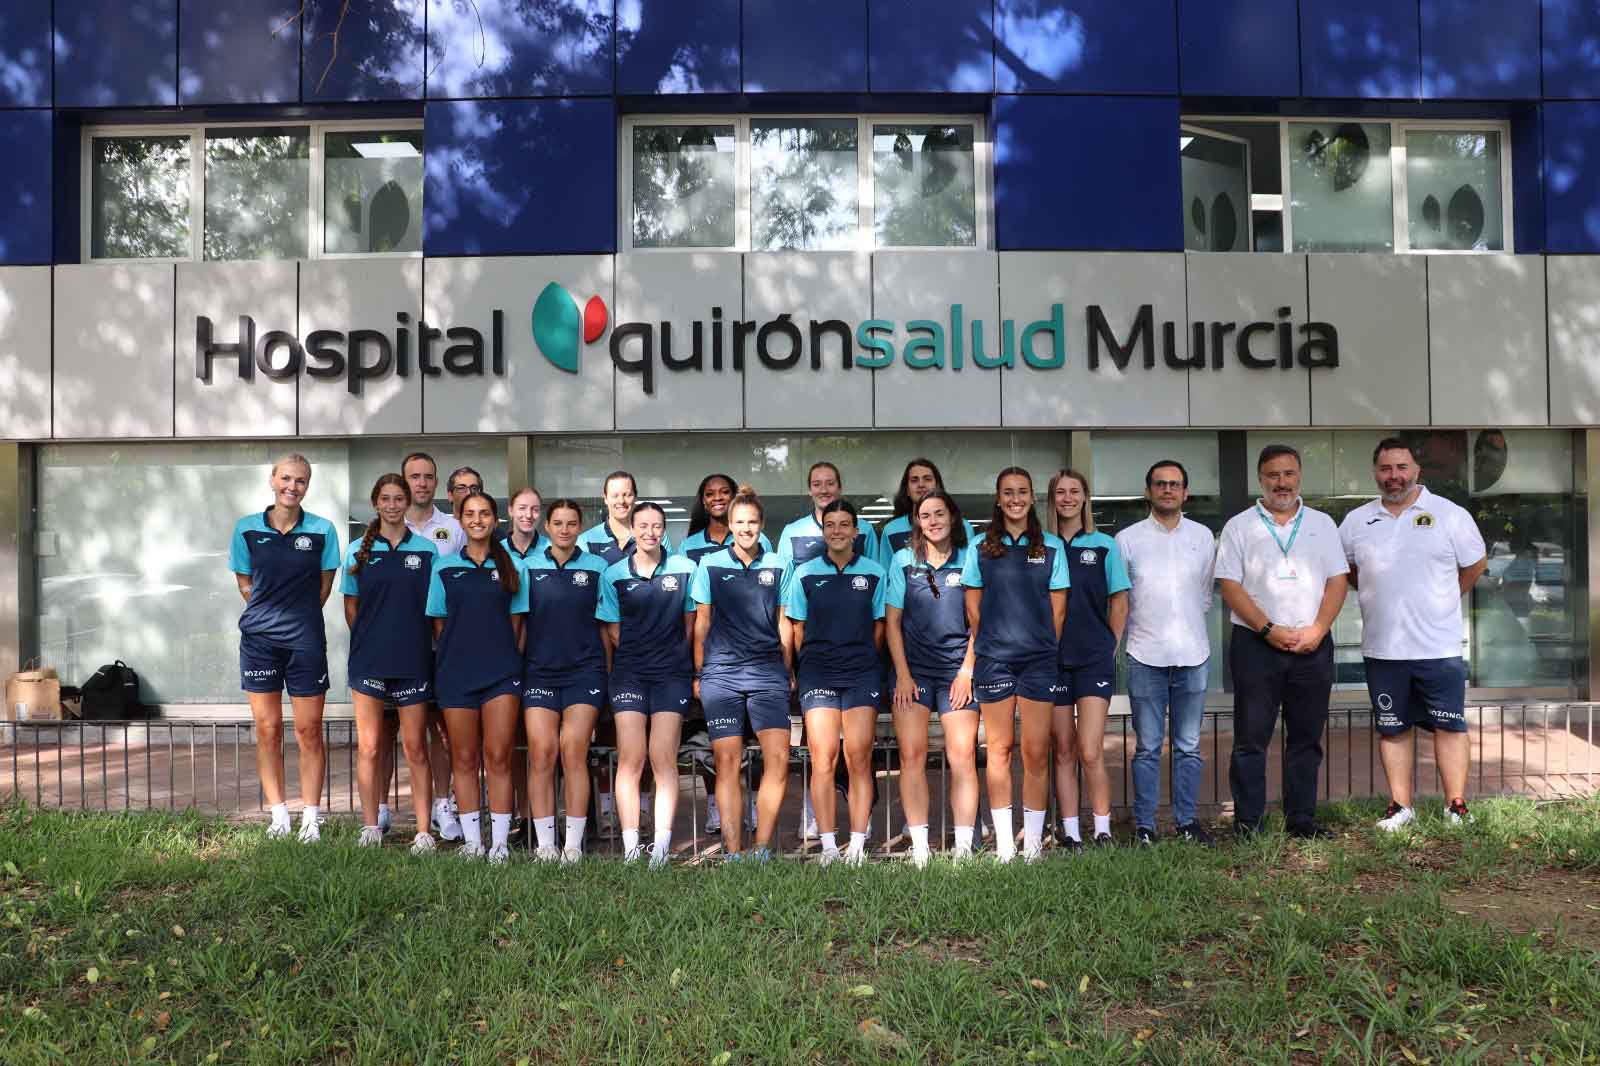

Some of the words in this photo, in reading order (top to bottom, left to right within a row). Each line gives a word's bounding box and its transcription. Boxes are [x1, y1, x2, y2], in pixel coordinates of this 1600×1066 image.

[196, 309, 504, 394] Hospital
[608, 304, 1066, 394] quirónsalud
[1086, 303, 1340, 372] Murcia
